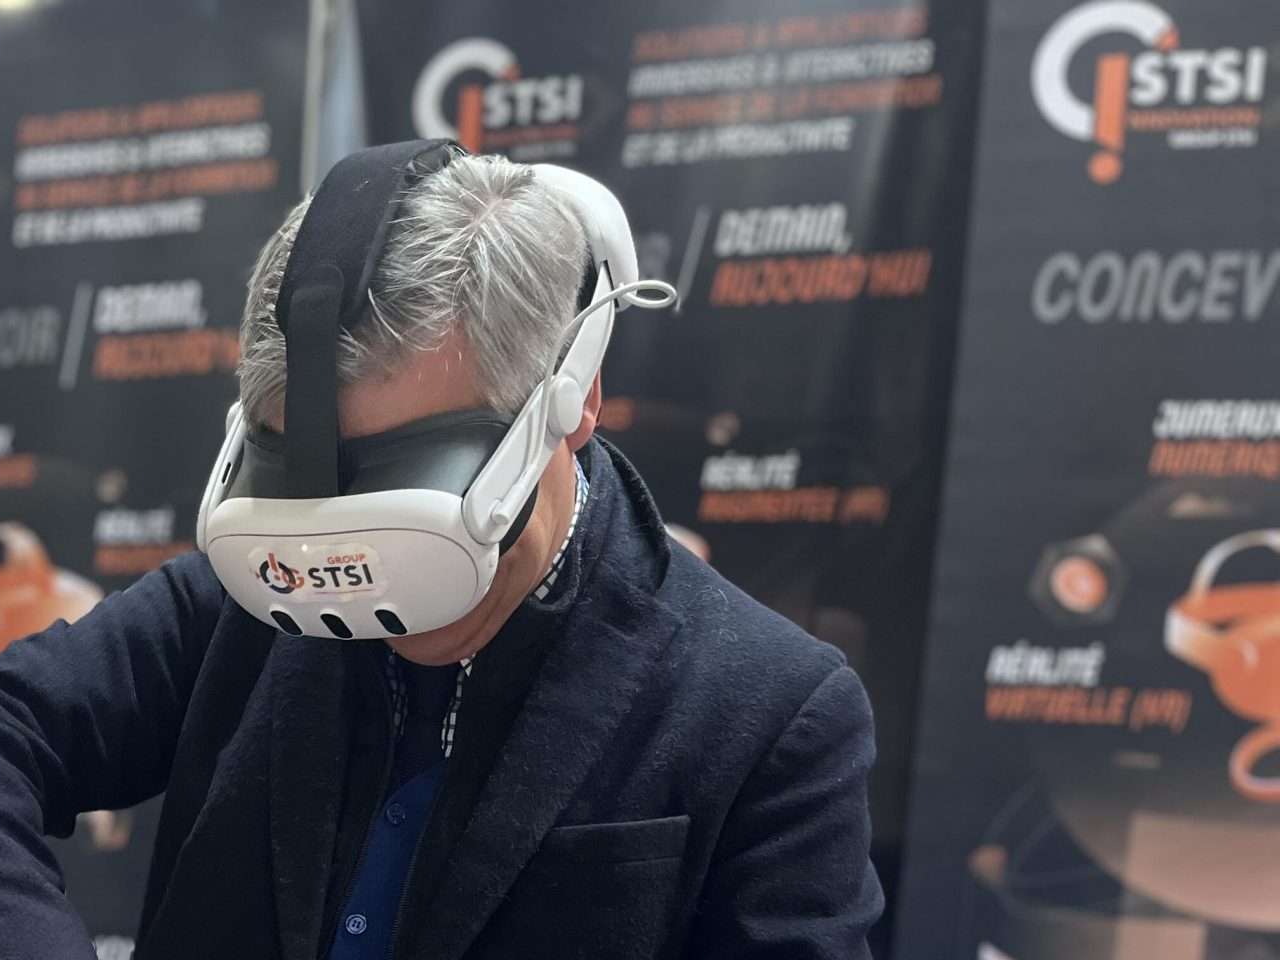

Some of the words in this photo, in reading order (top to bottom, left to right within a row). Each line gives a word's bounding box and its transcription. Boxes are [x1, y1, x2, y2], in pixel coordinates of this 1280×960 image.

[1129, 47, 1267, 105] STSI
[483, 74, 584, 130] STSI
[308, 563, 374, 588] STSI
[327, 553, 366, 565] GROUP
